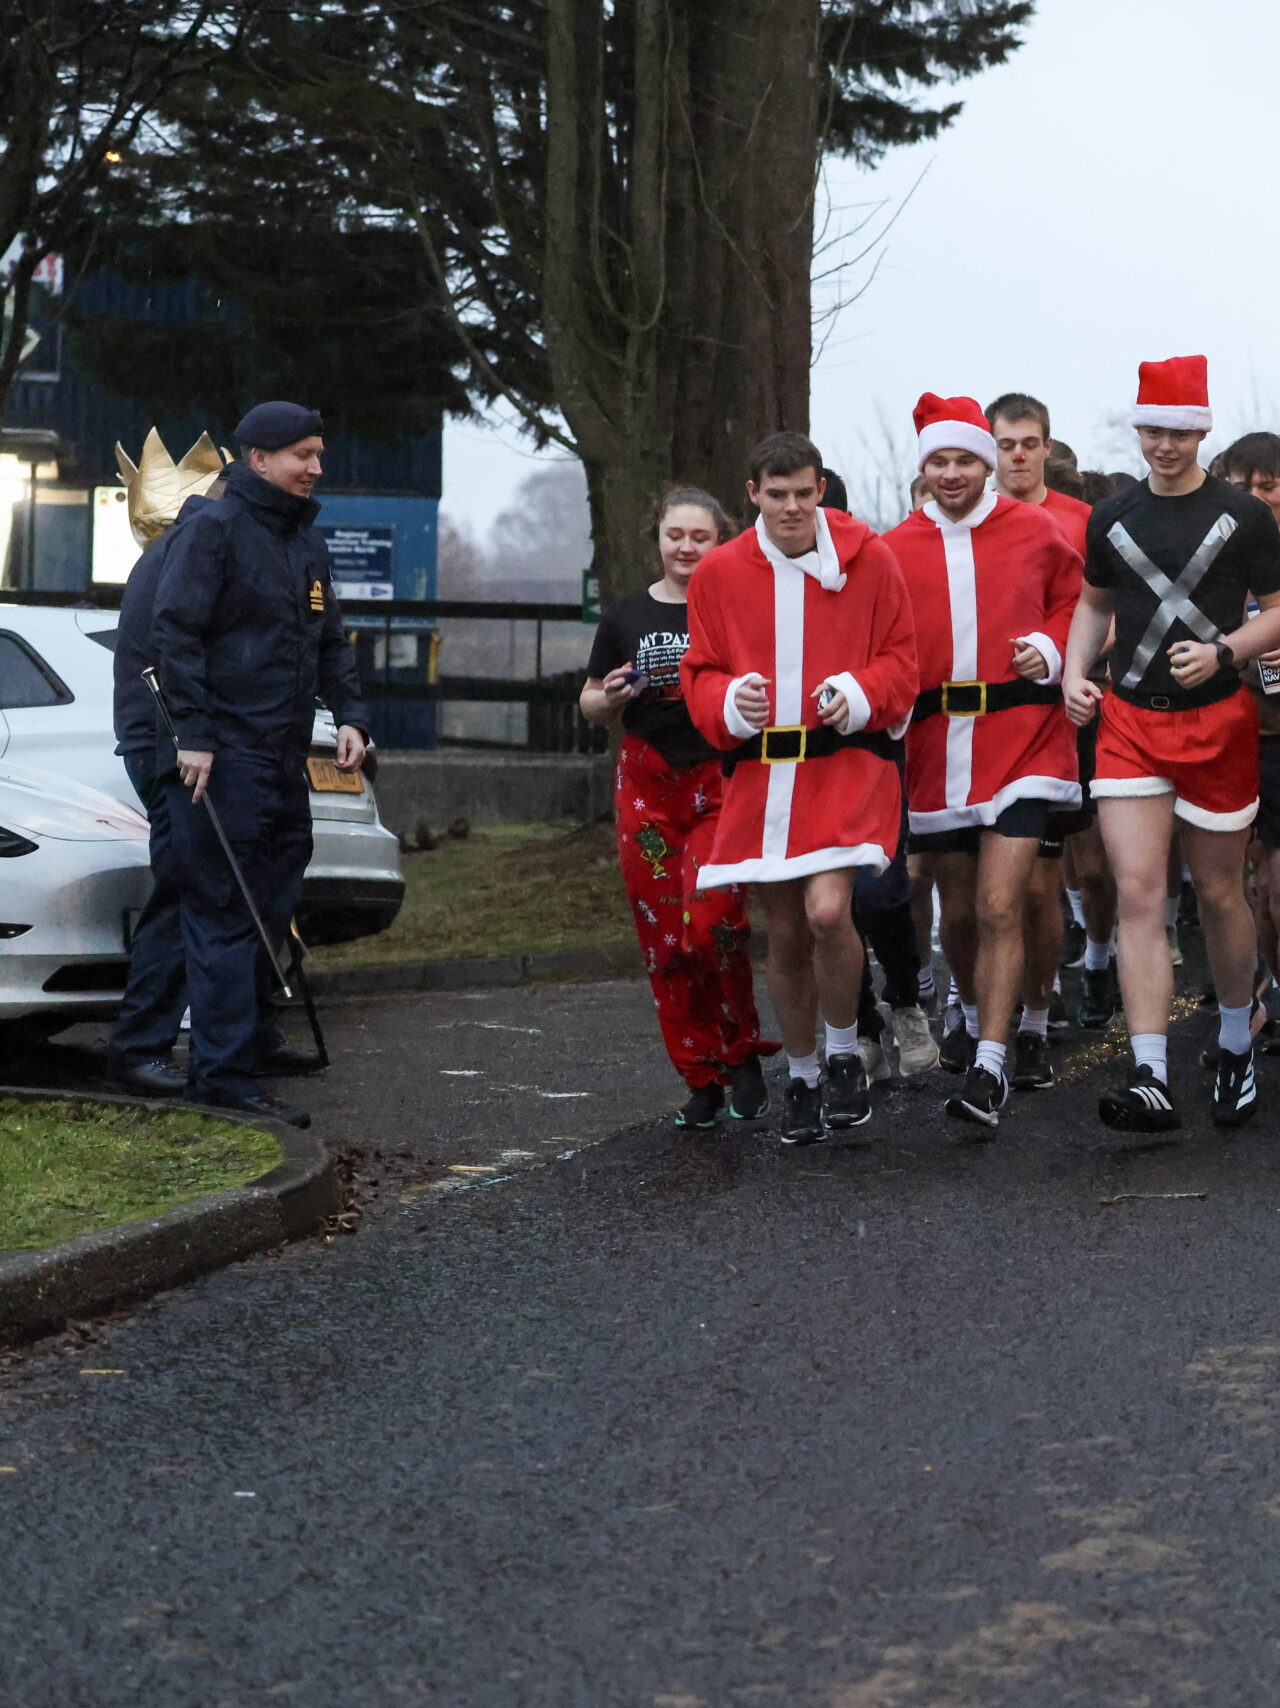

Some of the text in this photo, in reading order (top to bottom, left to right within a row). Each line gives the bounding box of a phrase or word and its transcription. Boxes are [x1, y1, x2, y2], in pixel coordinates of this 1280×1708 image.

[640, 632, 690, 650] MY DAY
[1107, 513, 1238, 690] X
